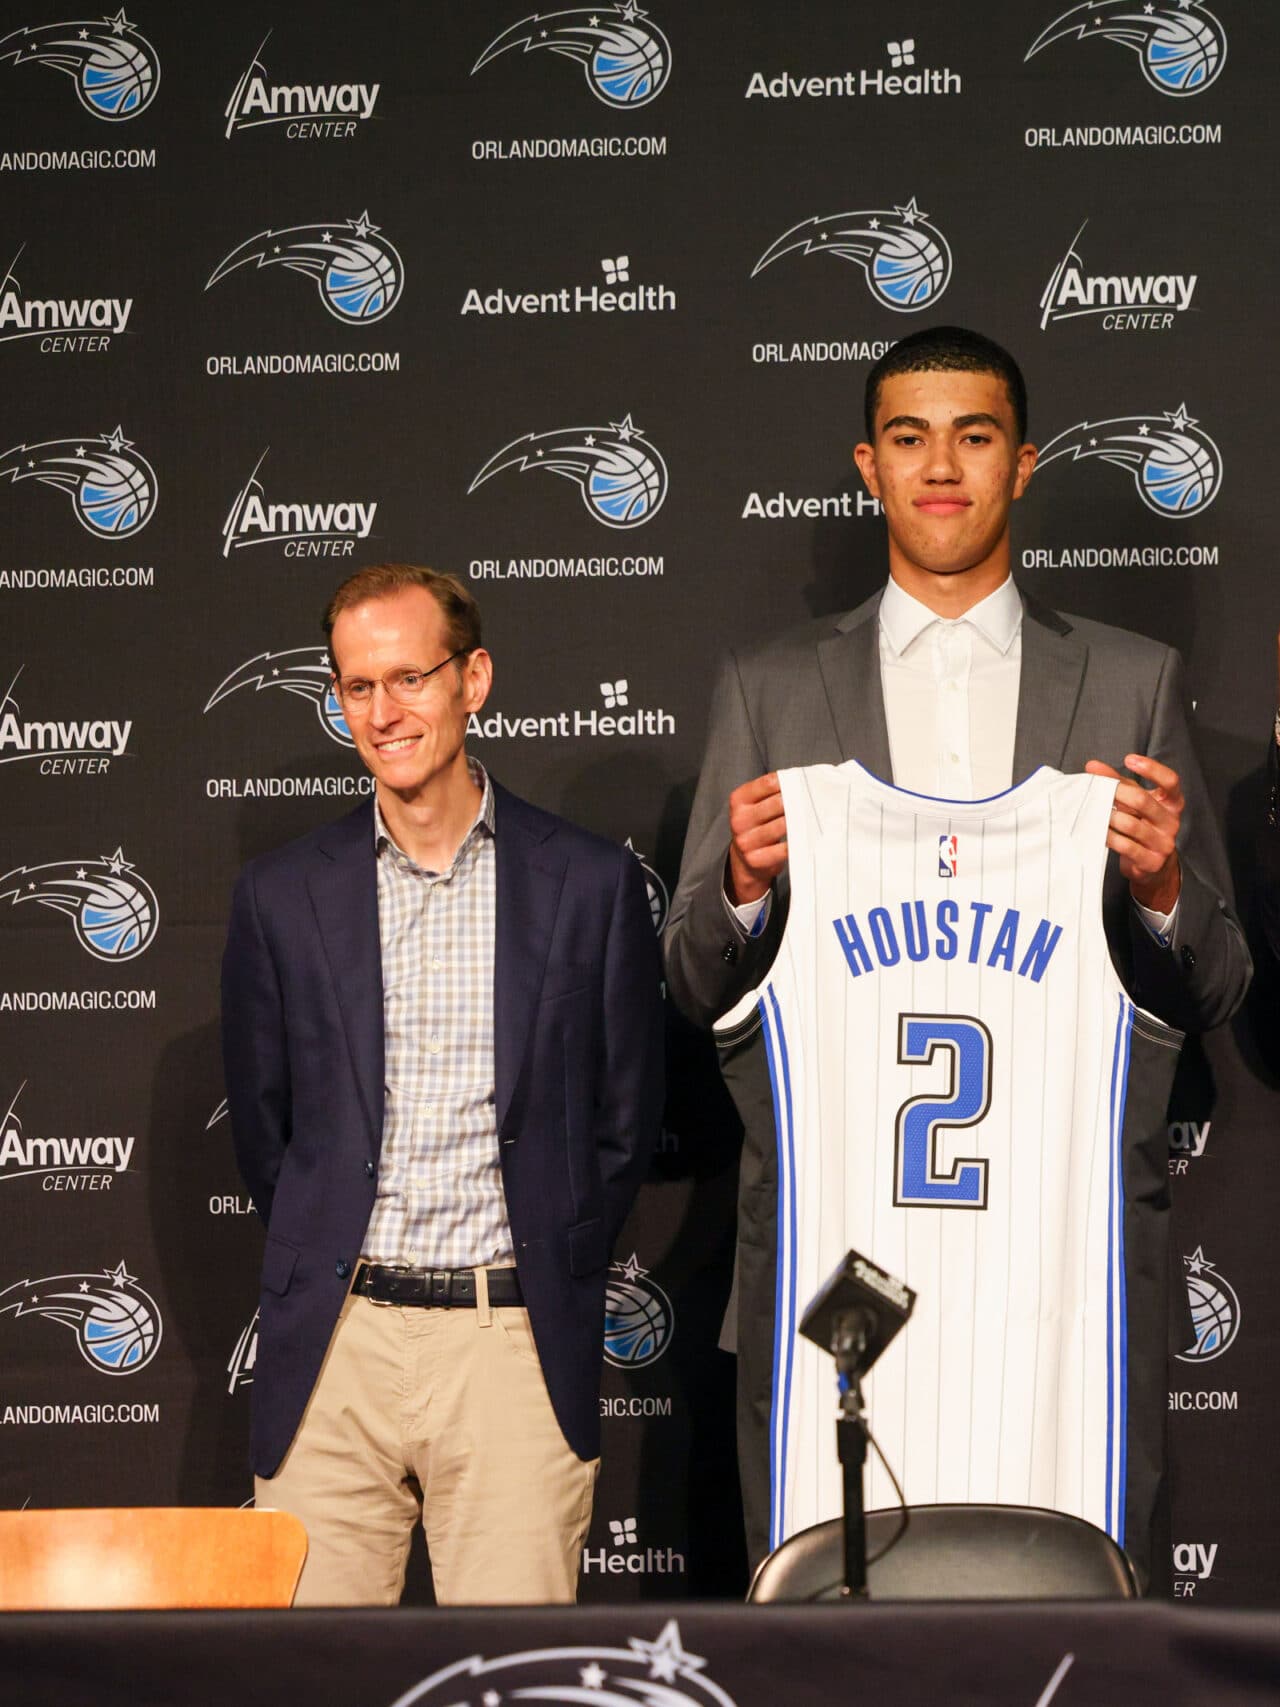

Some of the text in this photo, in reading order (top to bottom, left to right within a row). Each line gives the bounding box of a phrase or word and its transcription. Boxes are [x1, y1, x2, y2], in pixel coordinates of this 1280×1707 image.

[242, 78, 380, 119] Amway
[287, 122, 357, 138] CENTER
[1025, 125, 1221, 146] ORLANDOMAGIC.COM
[472, 137, 666, 159] ORLANDOMAGIC.COM
[1058, 268, 1198, 311] Amway
[0, 291, 133, 333] Amway
[1103, 313, 1174, 330] CENTER
[41, 336, 110, 352] CENTER
[207, 353, 399, 375] ORLANDOMAGIC.COM
[239, 496, 377, 538] Amway
[285, 541, 354, 557] CENTER
[1022, 547, 1218, 568] ORLANDOMAGIC.COM
[470, 557, 663, 579] ORLANDOMAGIC.COM
[0, 713, 133, 755] Amway
[40, 758, 110, 774] CENTER
[834, 901, 1061, 981] HOUSTAN
[893, 1013, 993, 1210] 2
[0, 1129, 135, 1172] Amway
[43, 1175, 112, 1191] CENTER
[0, 1404, 160, 1425] ANDOMAGIC.COM
